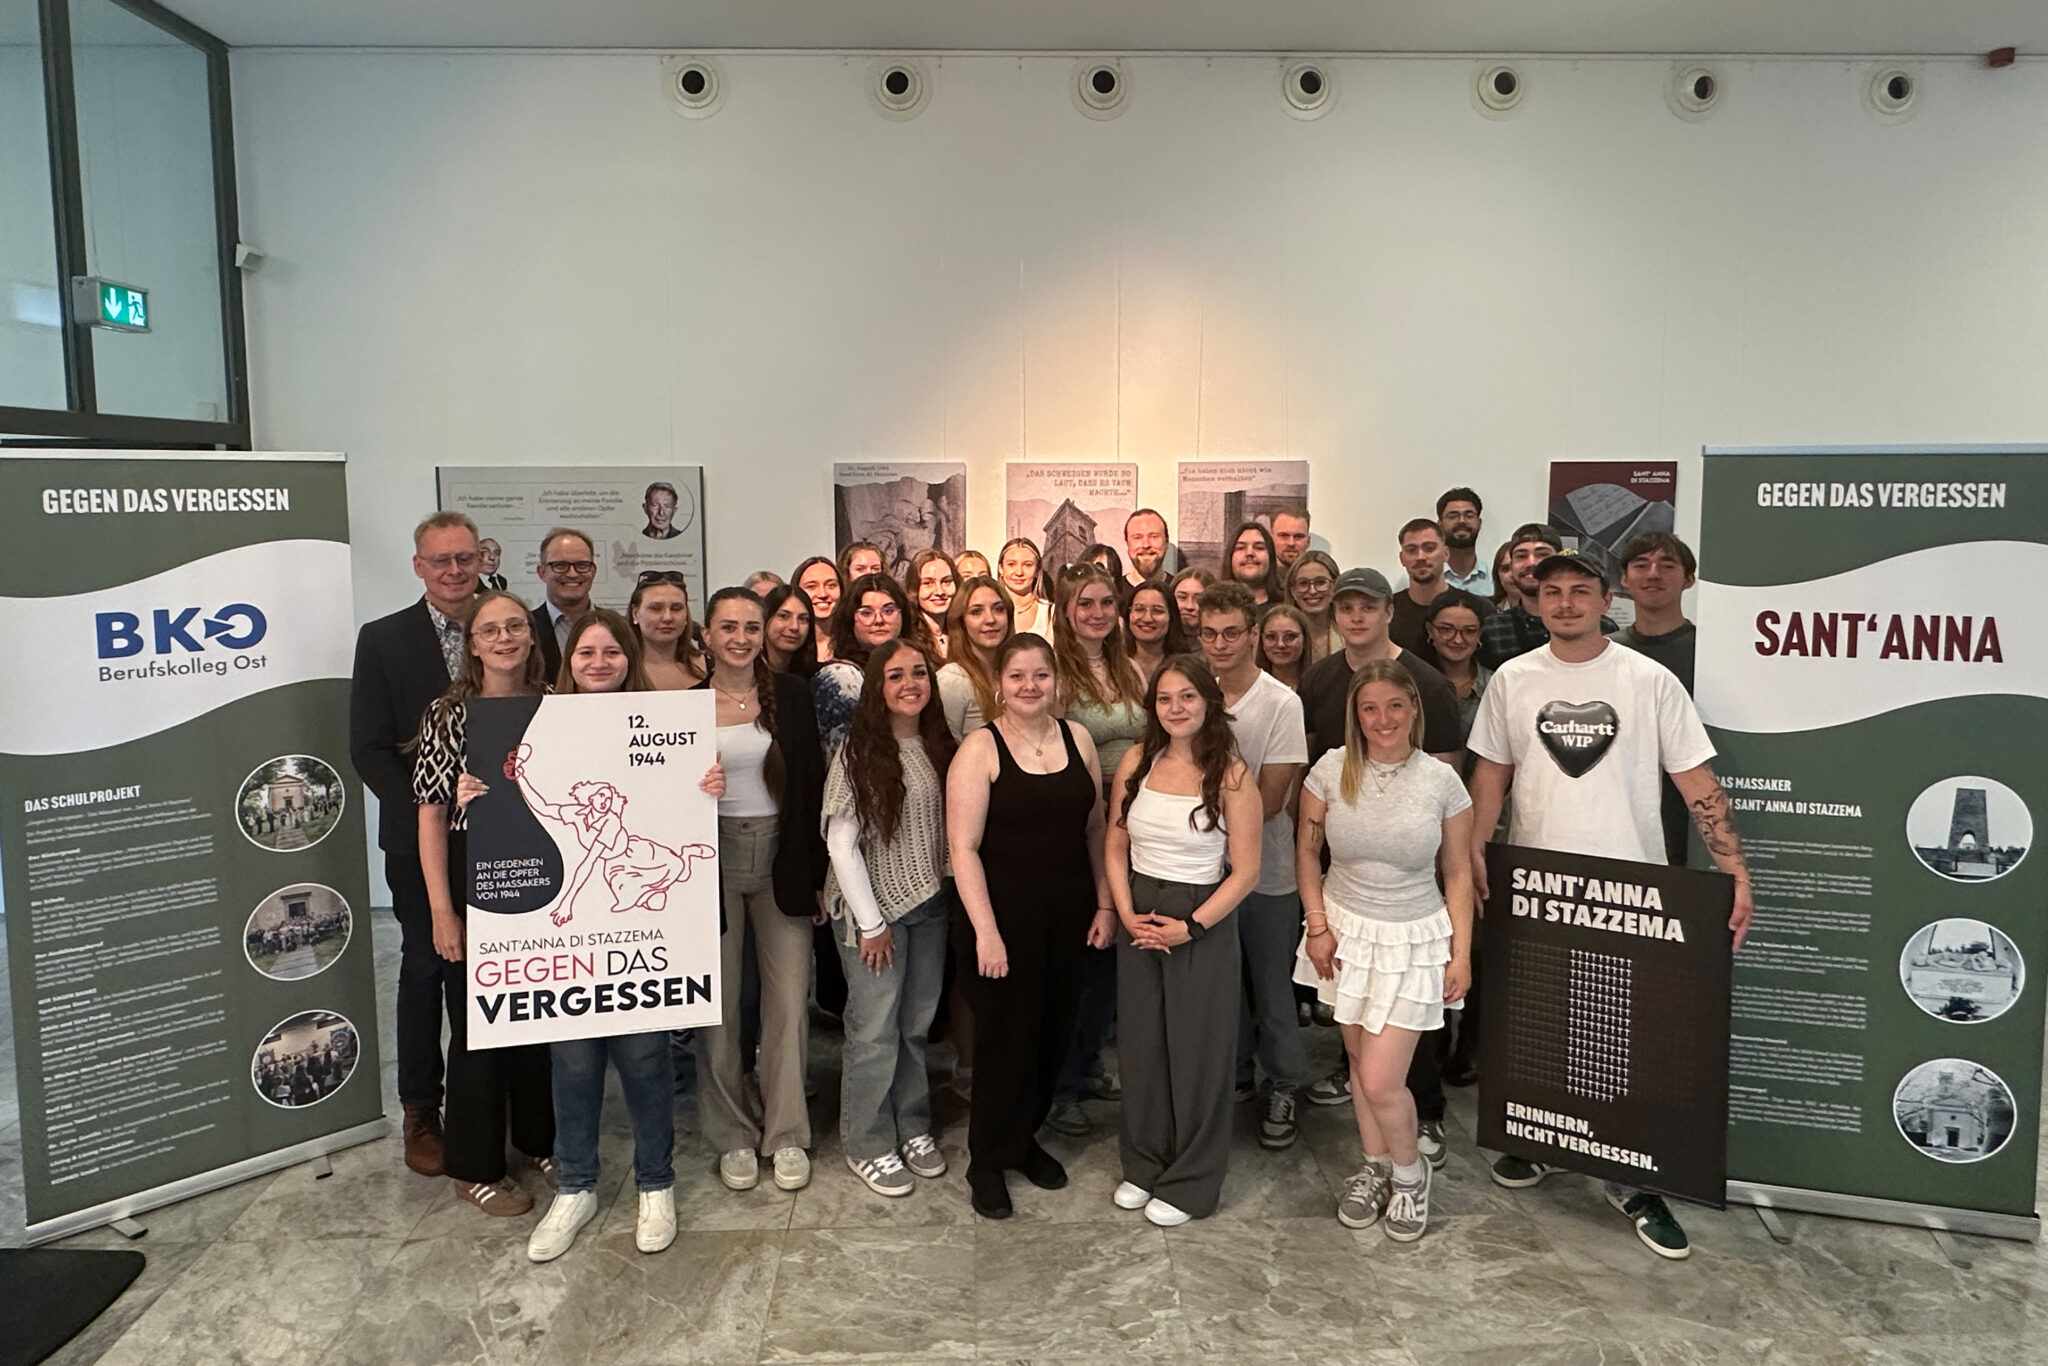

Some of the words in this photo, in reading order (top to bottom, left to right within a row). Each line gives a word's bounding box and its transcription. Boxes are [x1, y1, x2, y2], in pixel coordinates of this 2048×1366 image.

[42, 488, 119, 514] GEGEN
[124, 489, 169, 513] DAS
[171, 488, 290, 512] VERGESSEN
[1757, 482, 1826, 507] GEGEN
[1830, 482, 1874, 508] DAS
[1877, 482, 2007, 508] VERGESSEN
[98, 658, 227, 682] Berufskolleg
[233, 655, 268, 671] Ost
[628, 715, 650, 729] 12.
[1540, 720, 1615, 736] Carhartt
[628, 731, 697, 748] AUGUST
[1561, 734, 1594, 747] WIP
[628, 752, 666, 767] 1944
[1735, 777, 1792, 792] MASSAKER
[24, 798, 49, 813] DAS
[51, 785, 141, 809] SCHULPROJEKT
[1796, 802, 1808, 815] DI
[1808, 803, 1862, 818] STAZZEMA
[476, 860, 492, 871] EIN
[493, 857, 544, 869] GEDENKEN
[476, 870, 491, 880] AN
[492, 869, 508, 880] DIE
[509, 867, 540, 878] OPFER
[476, 880, 495, 891] DES
[496, 876, 551, 889] MASSAKERS
[1511, 867, 1663, 911] SANT'ANNA
[476, 890, 499, 900] VON
[500, 889, 521, 899] 1944
[1511, 895, 1539, 919] DI
[1544, 902, 1685, 943] STAZZEMA
[570, 934, 584, 947] DI
[588, 928, 664, 946] STAZZEMA
[475, 952, 595, 987] GEGEN
[607, 946, 669, 976] DAS
[476, 974, 712, 1024] VERGESSEN
[1506, 1101, 1594, 1138] ERINNERN,
[1506, 1120, 1556, 1146] NICHT
[1556, 1132, 1659, 1172] VERGESSEN.
